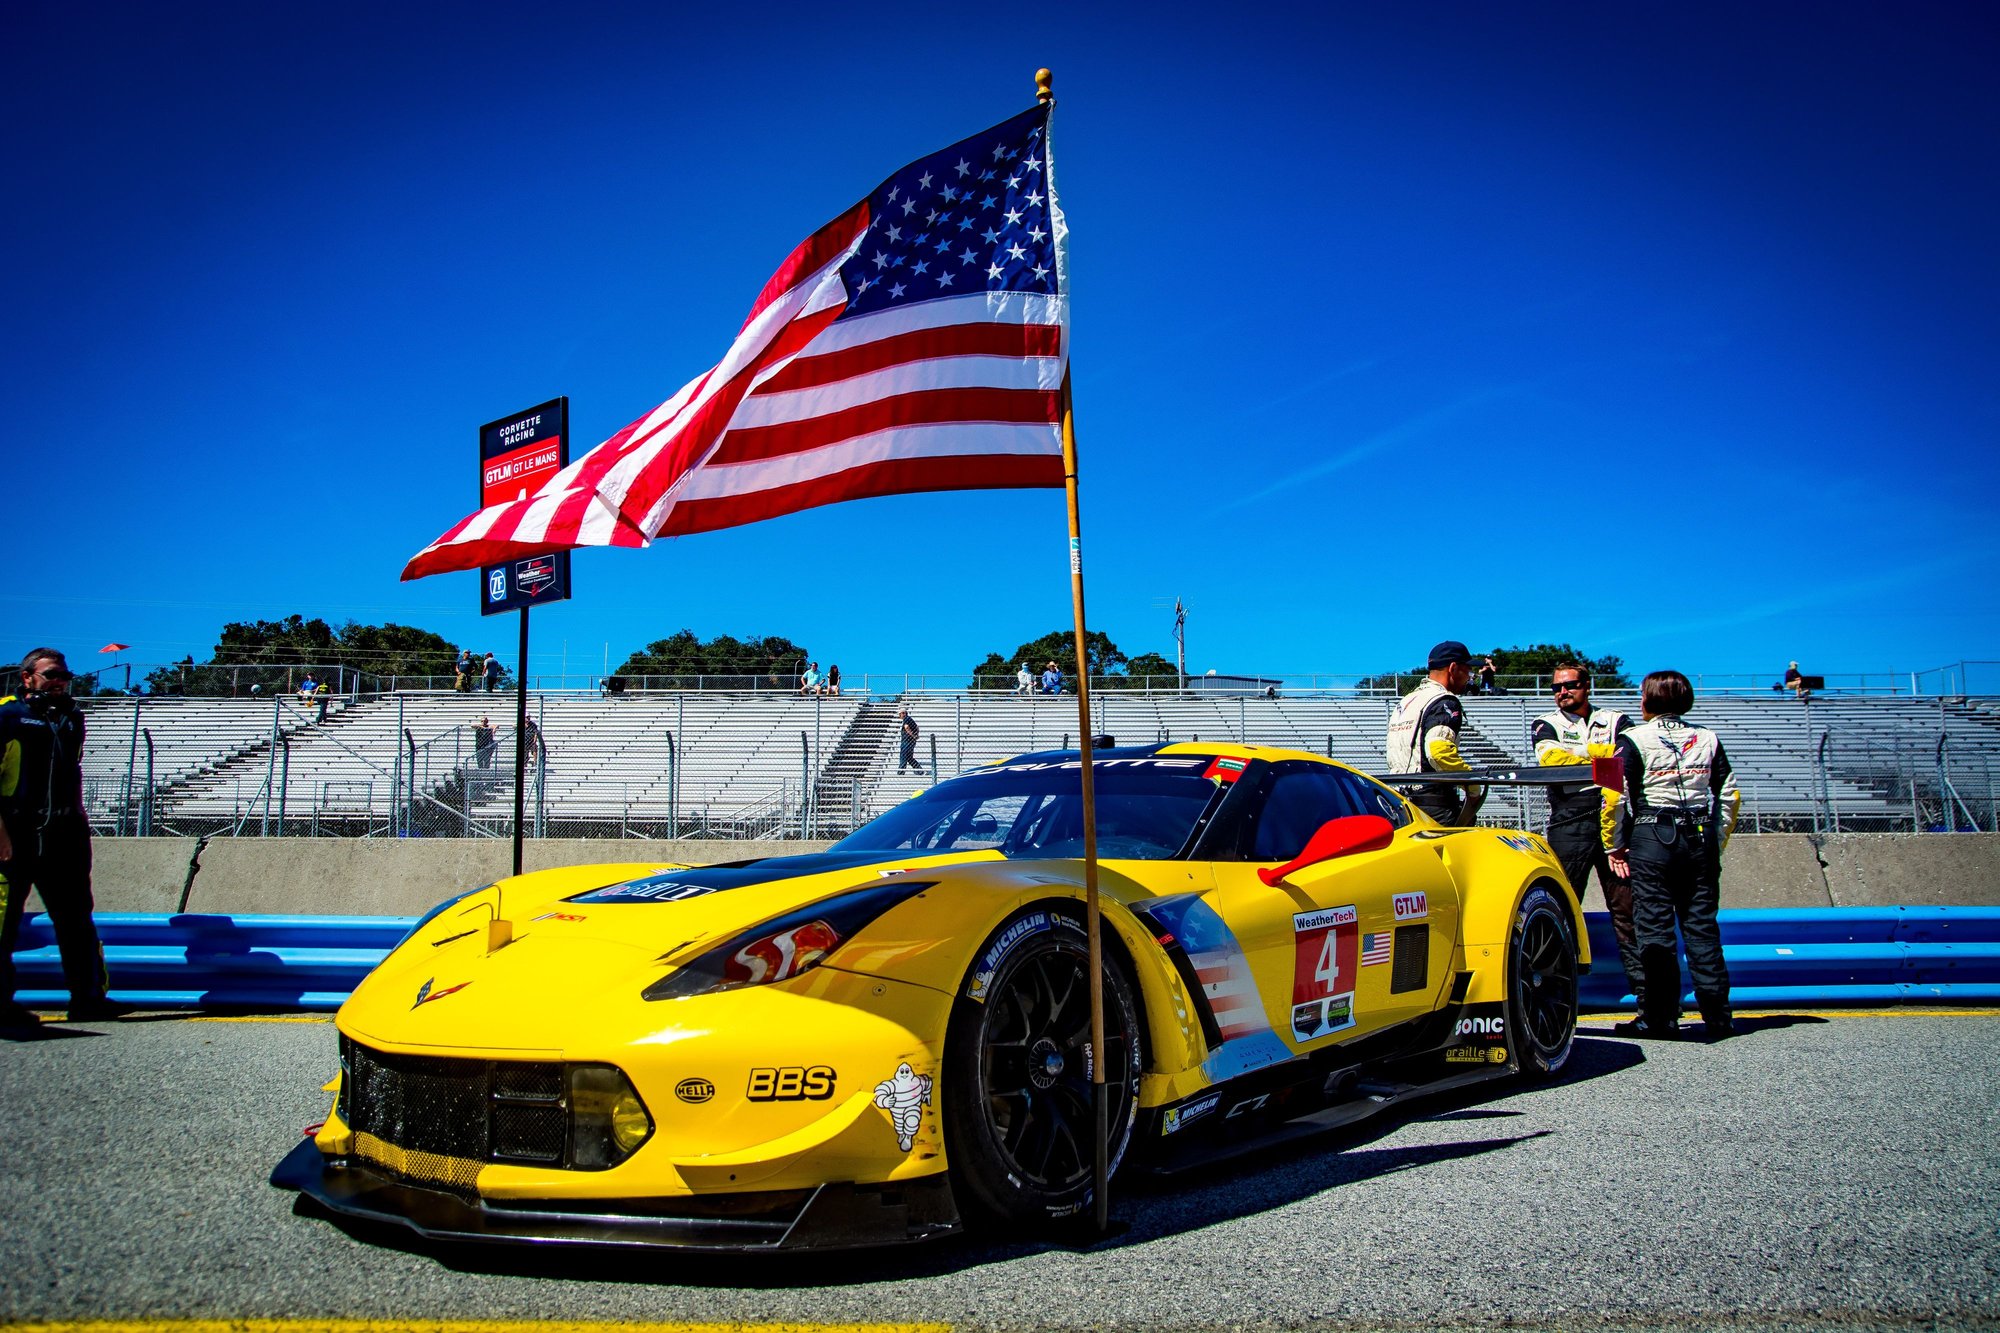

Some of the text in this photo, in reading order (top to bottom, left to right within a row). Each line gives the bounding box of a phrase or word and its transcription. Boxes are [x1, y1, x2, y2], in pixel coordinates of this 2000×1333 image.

[500, 415, 541, 437] CORVETTE
[505, 428, 535, 446] RACING
[486, 451, 557, 485] GTLM GT LE MANS
[490, 574, 505, 596] ZF
[1394, 895, 1427, 916] GTLM
[1296, 910, 1354, 929] WeatherTech
[985, 913, 1045, 968] MICHELIN
[1314, 929, 1340, 993] 4
[678, 1084, 716, 1096] HELLA
[746, 1065, 837, 1103] BBS
[1180, 1096, 1219, 1121] MICHELIN
